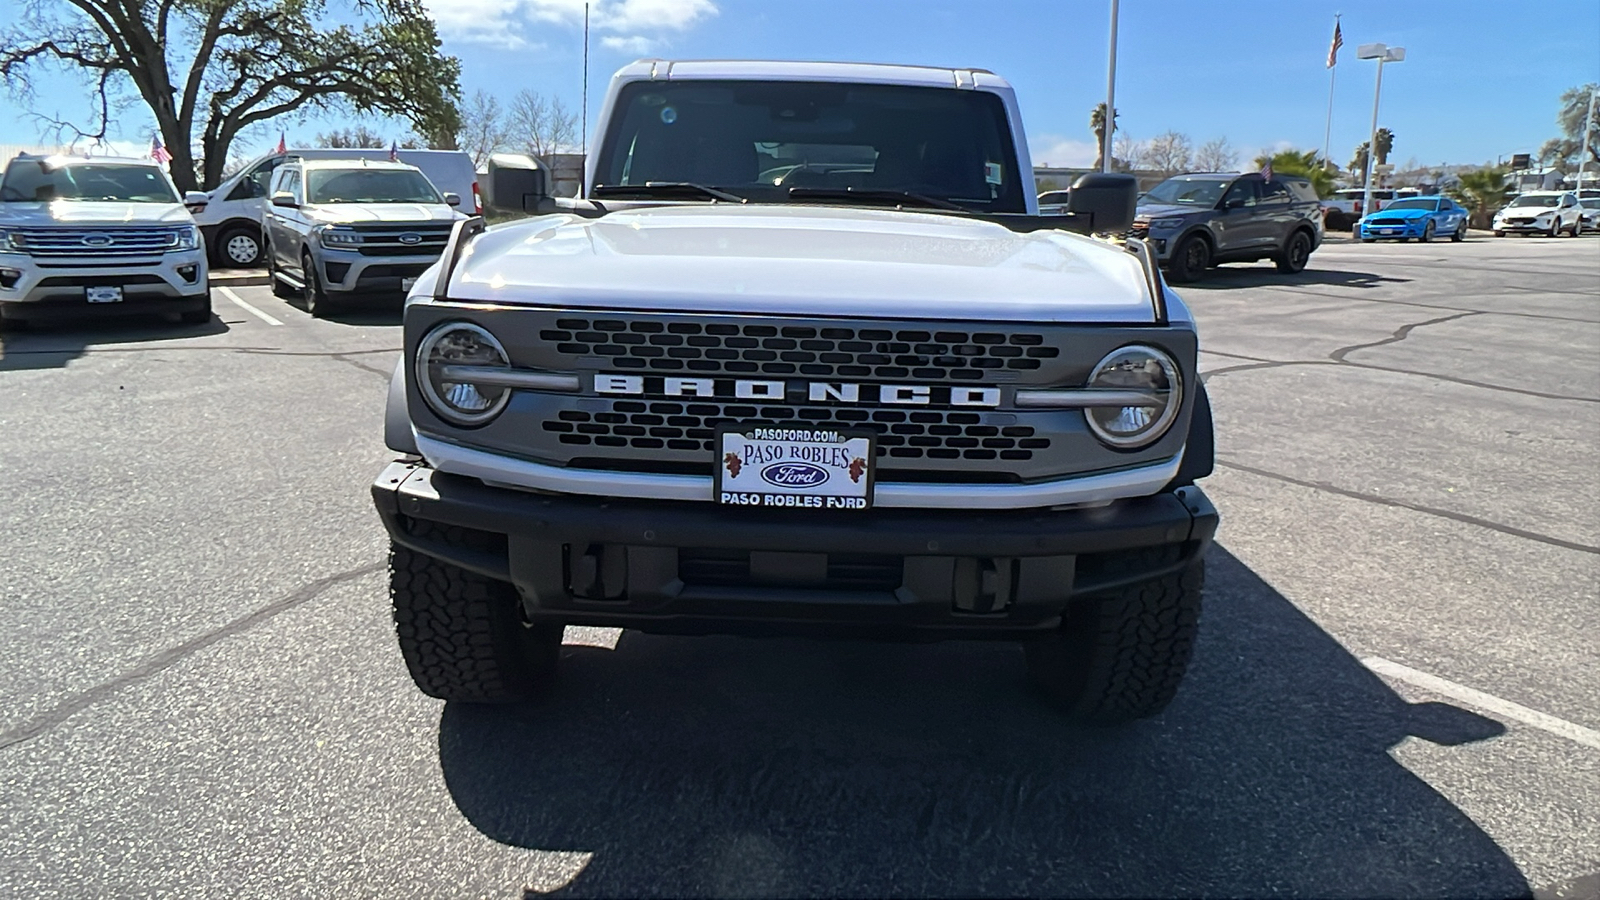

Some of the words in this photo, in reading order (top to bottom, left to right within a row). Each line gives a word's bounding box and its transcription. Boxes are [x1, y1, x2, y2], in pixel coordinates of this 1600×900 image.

[594, 374, 1000, 406] BRONCO
[754, 428, 838, 442] PASOFORD.COM
[743, 444, 783, 466] PASO
[790, 446, 849, 469] ROBLES
[774, 466, 816, 483] Ford
[721, 492, 760, 505] PASO
[764, 494, 823, 507] ROBLES
[826, 496, 867, 509] FORD
